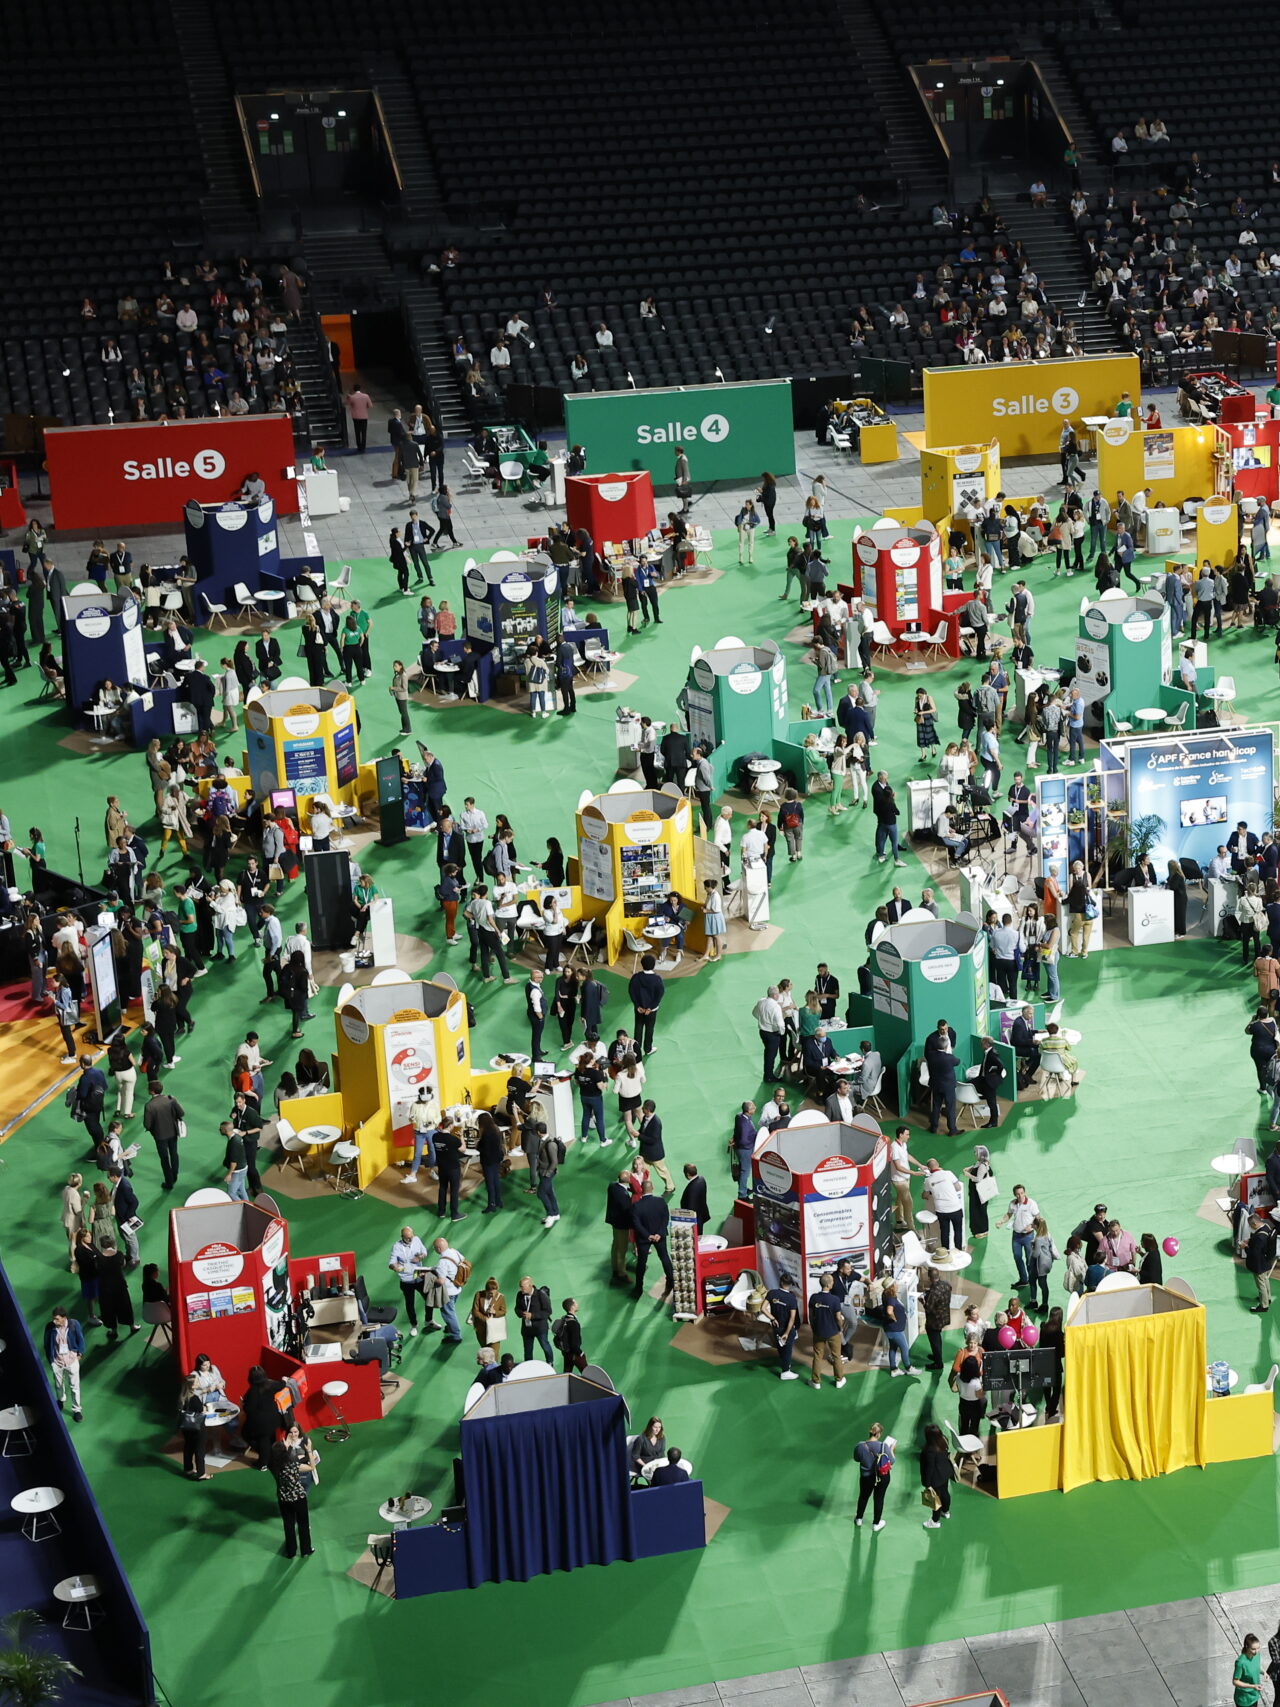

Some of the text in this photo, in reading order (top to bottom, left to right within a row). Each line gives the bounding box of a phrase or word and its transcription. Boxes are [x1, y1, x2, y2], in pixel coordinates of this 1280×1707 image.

[992, 394, 1049, 417] Salle
[636, 421, 698, 444] Salle
[123, 457, 190, 481] Salle
[1157, 753, 1178, 764] APF
